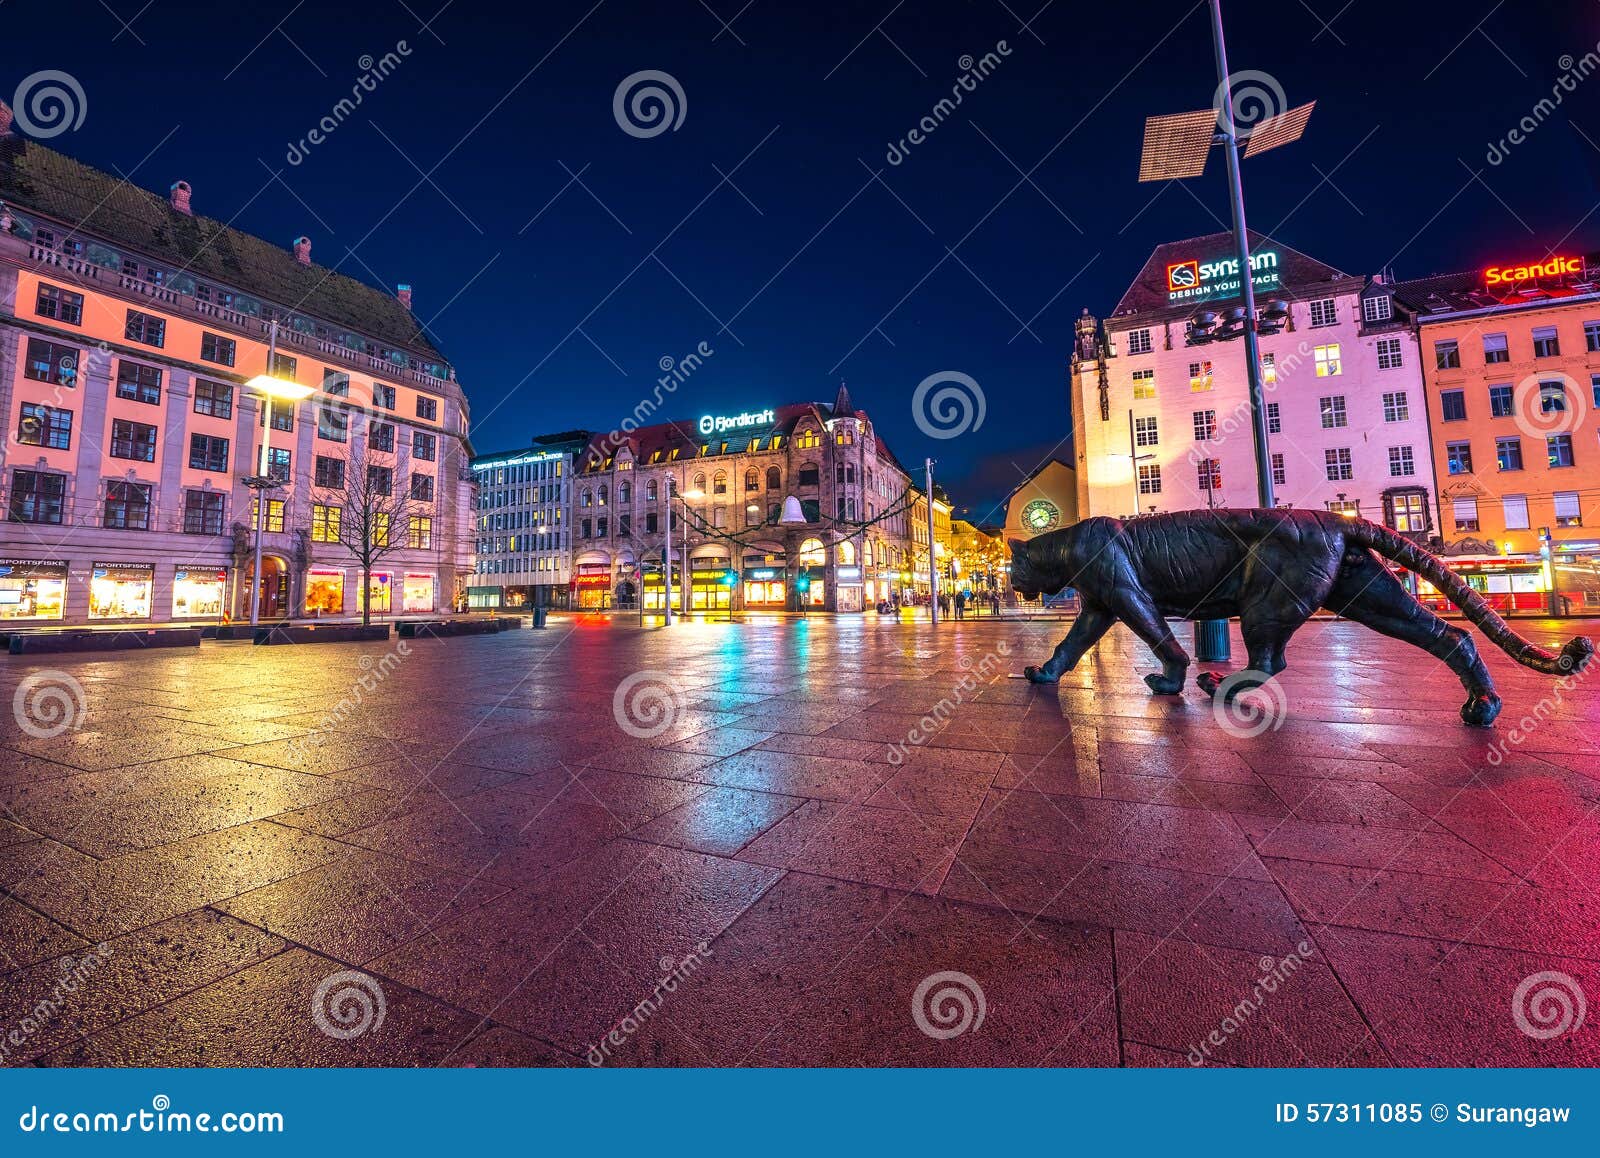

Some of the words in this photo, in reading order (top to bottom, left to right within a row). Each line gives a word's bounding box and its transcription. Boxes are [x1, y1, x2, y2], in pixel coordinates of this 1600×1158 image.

[1486, 257, 1581, 284] Scandic
[1169, 286, 1211, 299] DESIGN
[1214, 281, 1240, 292] YOU
[715, 409, 774, 432] Fjordkraft
